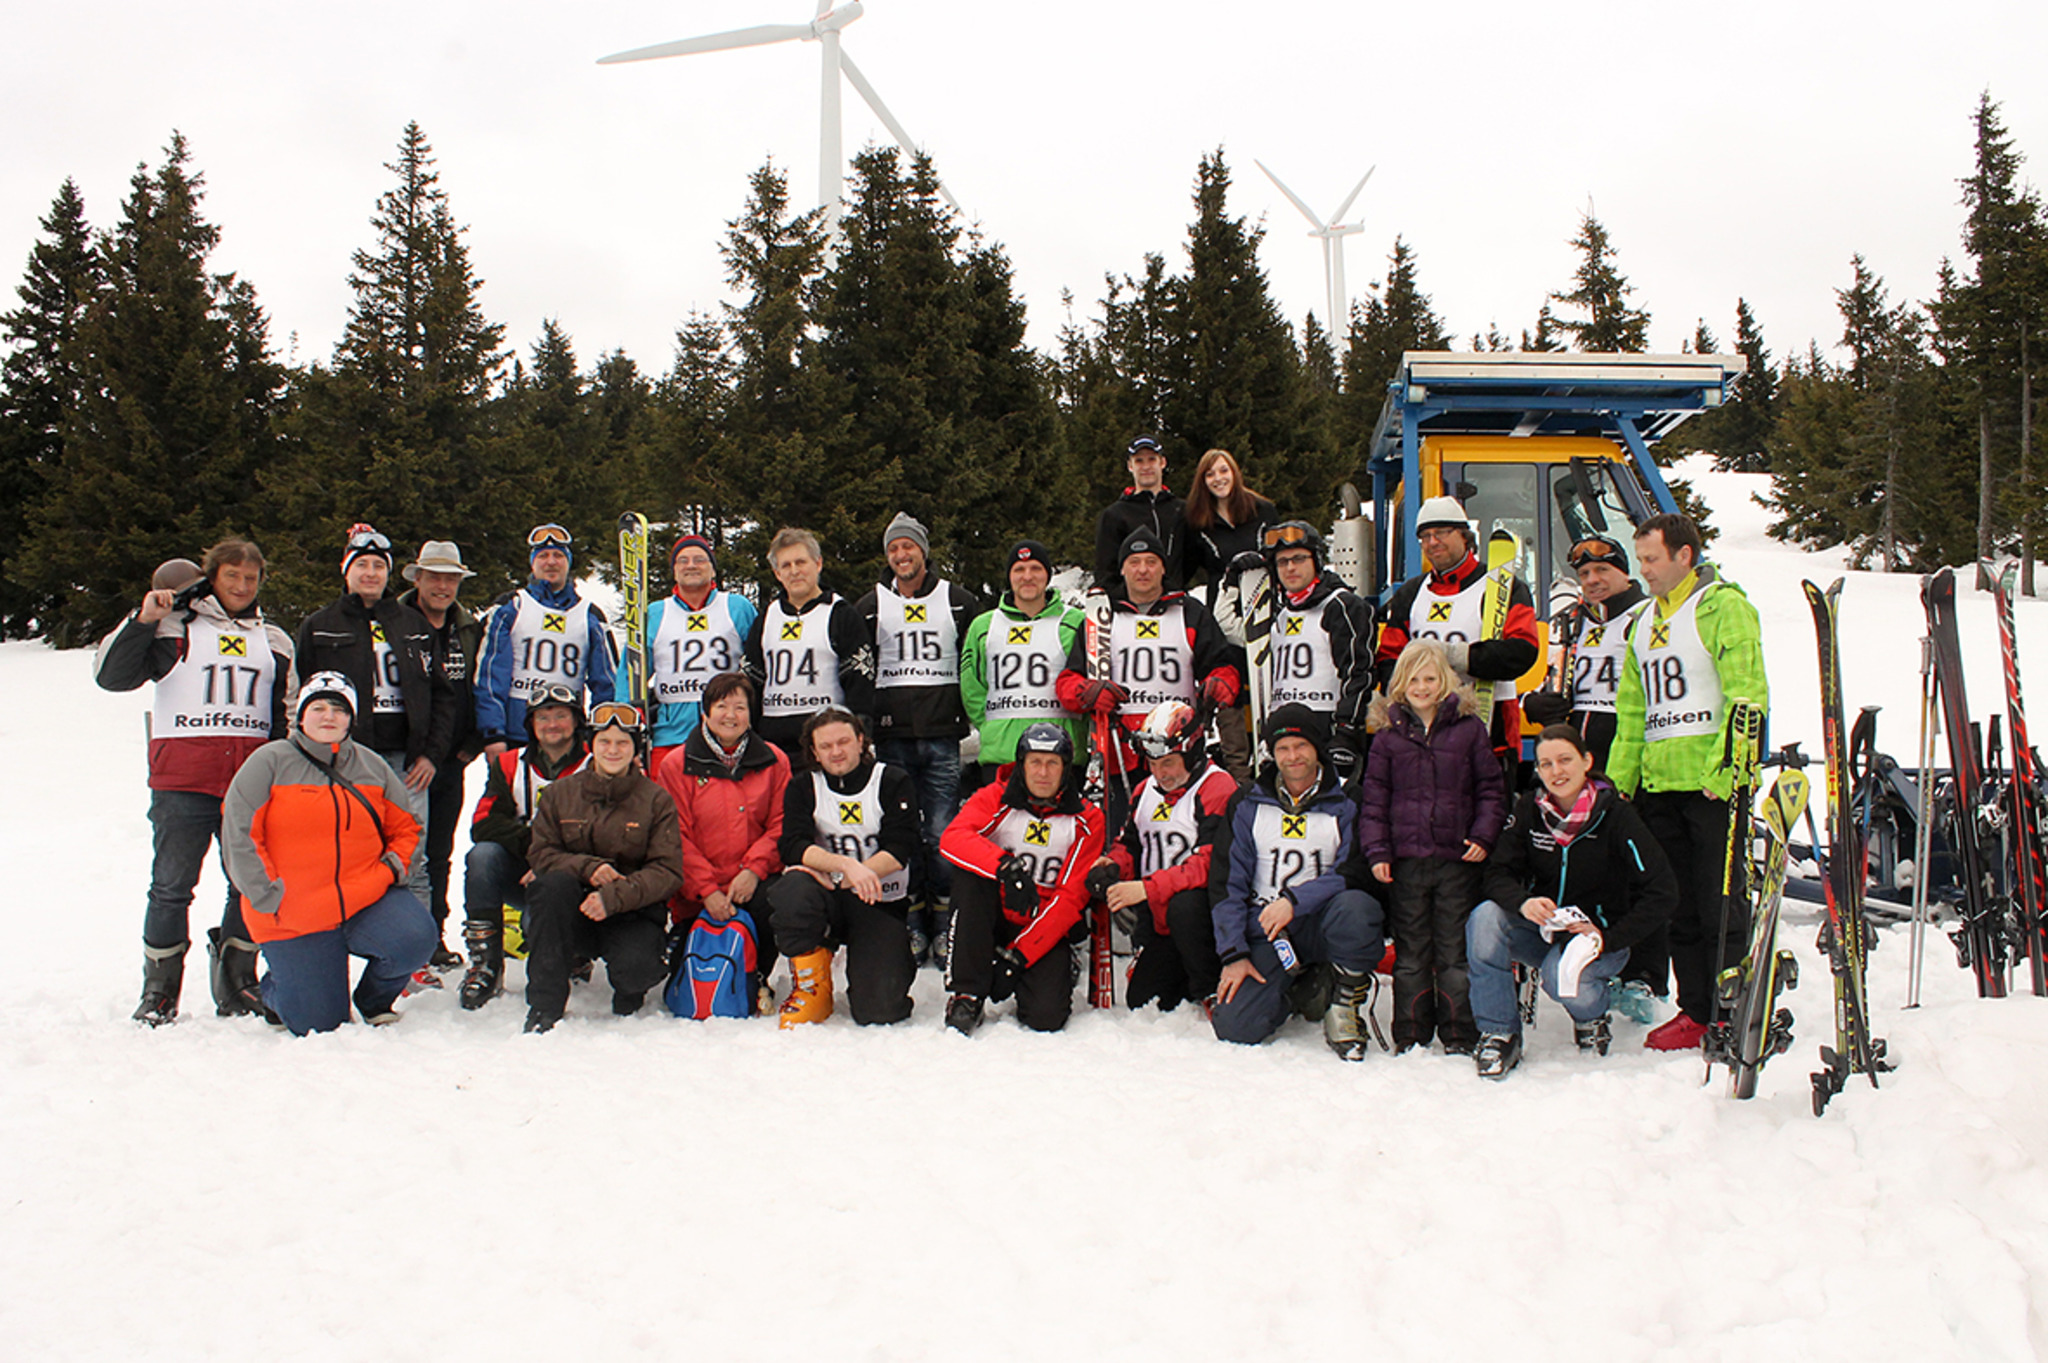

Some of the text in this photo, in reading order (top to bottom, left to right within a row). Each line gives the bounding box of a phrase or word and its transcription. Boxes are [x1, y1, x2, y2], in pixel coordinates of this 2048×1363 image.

[622, 531, 641, 651] FISCHER
[1492, 573, 1512, 641] SCHER
[521, 636, 580, 679] 108
[670, 636, 731, 673] 123
[894, 630, 942, 662] 115
[1097, 605, 1111, 679] OMIC
[1275, 642, 1313, 681] 119
[201, 663, 262, 707] 117
[766, 647, 819, 686] 104
[992, 652, 1049, 691] 126
[1118, 646, 1181, 684] 105
[1575, 655, 1618, 695] 24
[1642, 655, 1687, 706] 118
[174, 712, 270, 731] Raiffeise
[1143, 830, 1189, 871] 112
[1270, 847, 1322, 889] 121
